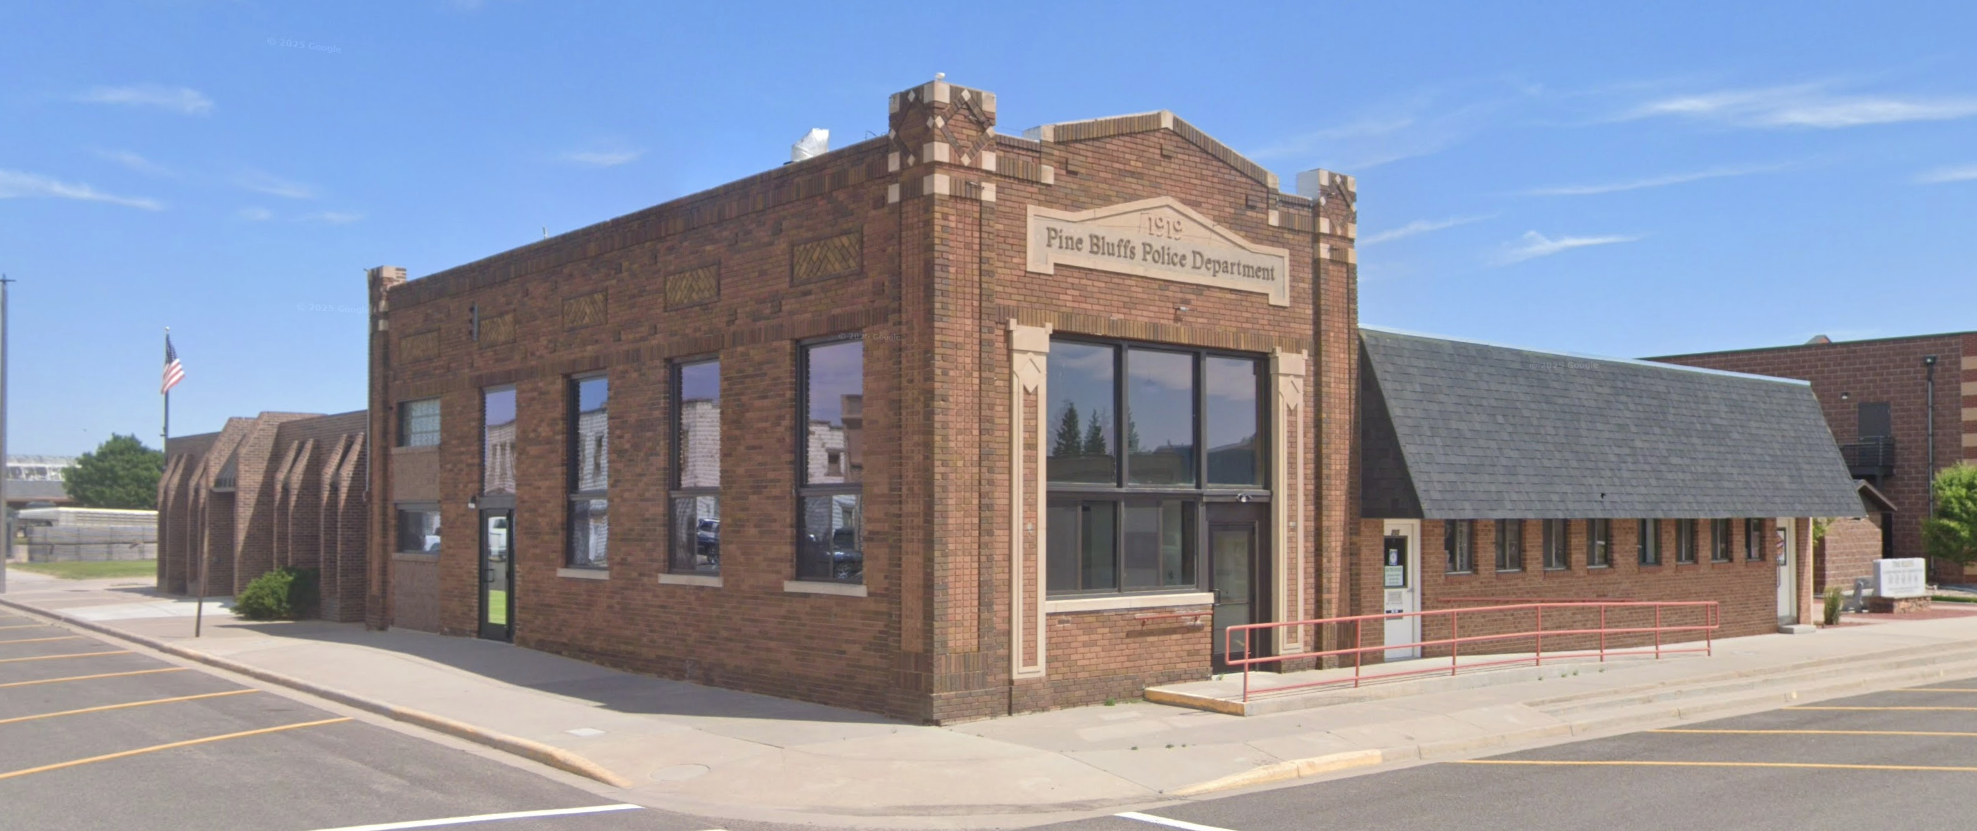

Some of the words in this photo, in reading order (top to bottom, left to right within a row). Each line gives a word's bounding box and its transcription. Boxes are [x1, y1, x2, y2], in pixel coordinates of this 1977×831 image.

[1148, 216, 1183, 241] 1919
[1046, 226, 1084, 252] Pine
[1088, 233, 1136, 260] Bluffs
[1141, 242, 1188, 268] Police
[1191, 250, 1276, 281] Department
